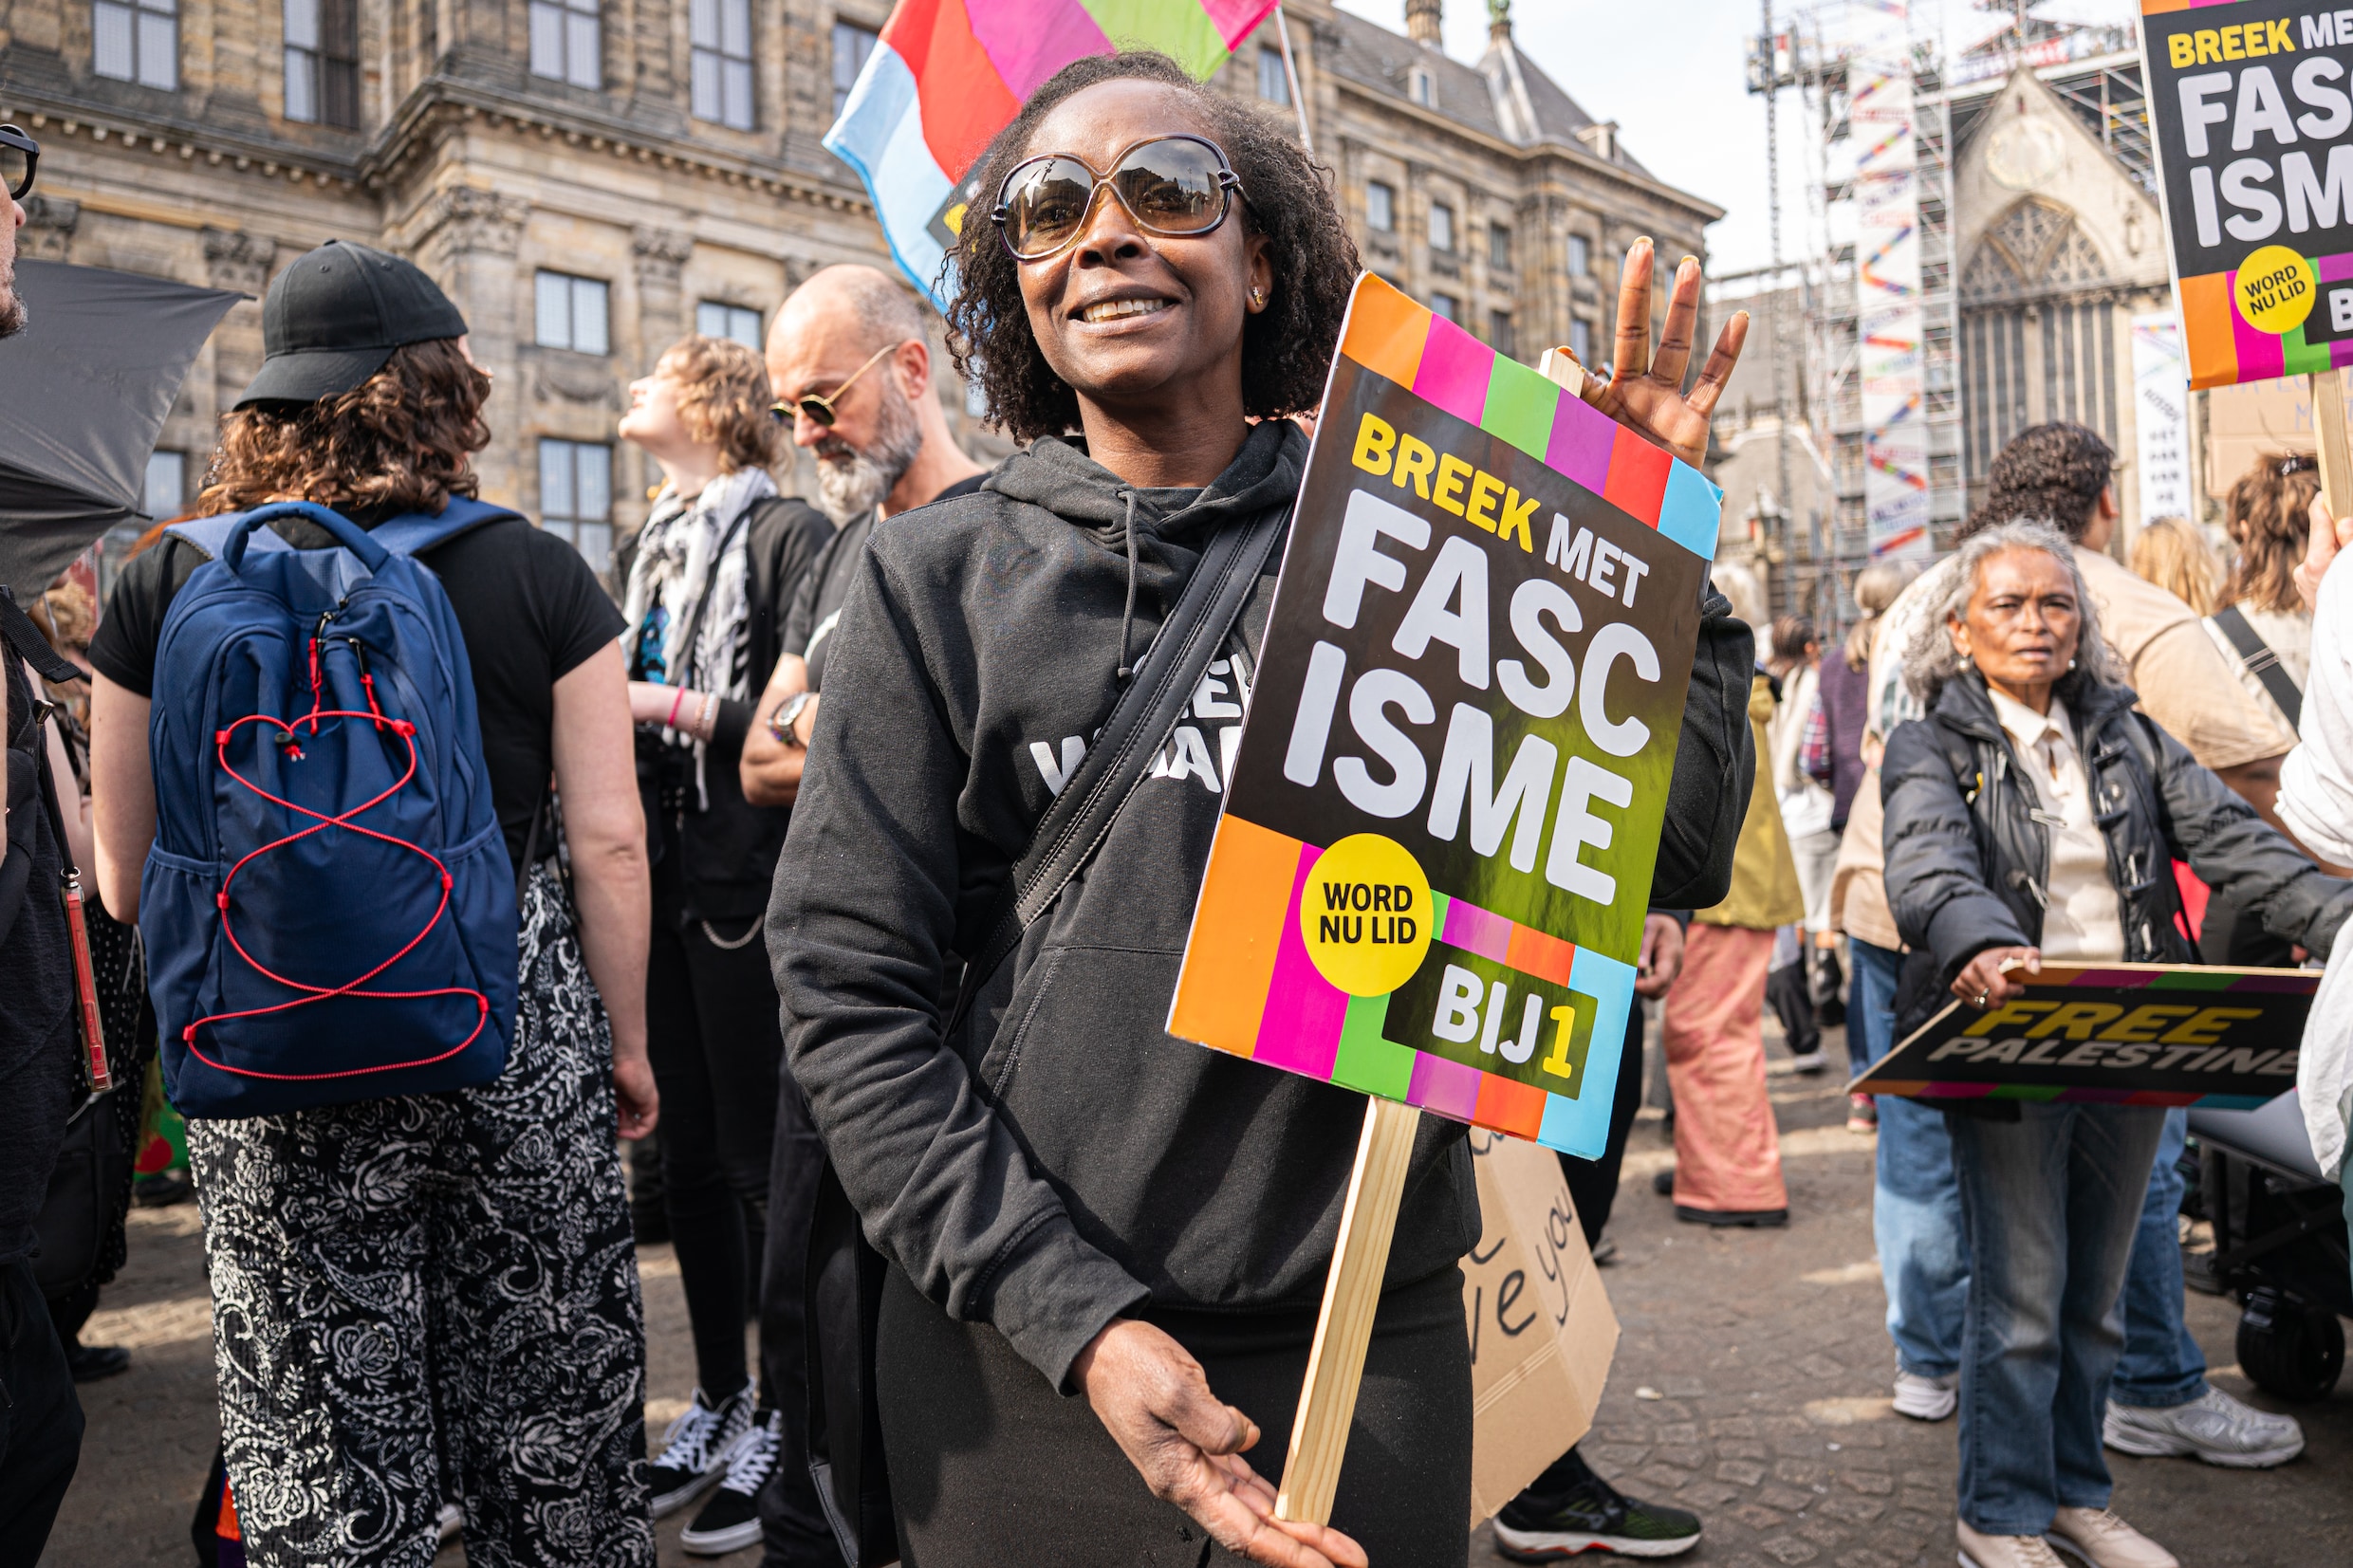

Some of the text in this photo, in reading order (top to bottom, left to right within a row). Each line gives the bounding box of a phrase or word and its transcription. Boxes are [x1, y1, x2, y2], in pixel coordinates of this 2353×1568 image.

[2168, 18, 2296, 68] BREEK
[2177, 56, 2353, 158] FAS
[2245, 266, 2297, 298] WORD
[2250, 280, 2306, 315] NU LID
[1352, 412, 1649, 608] BREEK MET
[1322, 489, 1661, 758] FASC
[1284, 640, 1633, 906] ISME
[1322, 882, 1413, 912] WORD
[1320, 916, 1417, 944] NU LID
[1432, 962, 1575, 1079] BIJ1
[1963, 1001, 2263, 1044] FREE
[1927, 1037, 2300, 1077] PALESTINE
[1535, 1187, 1573, 1326] you
